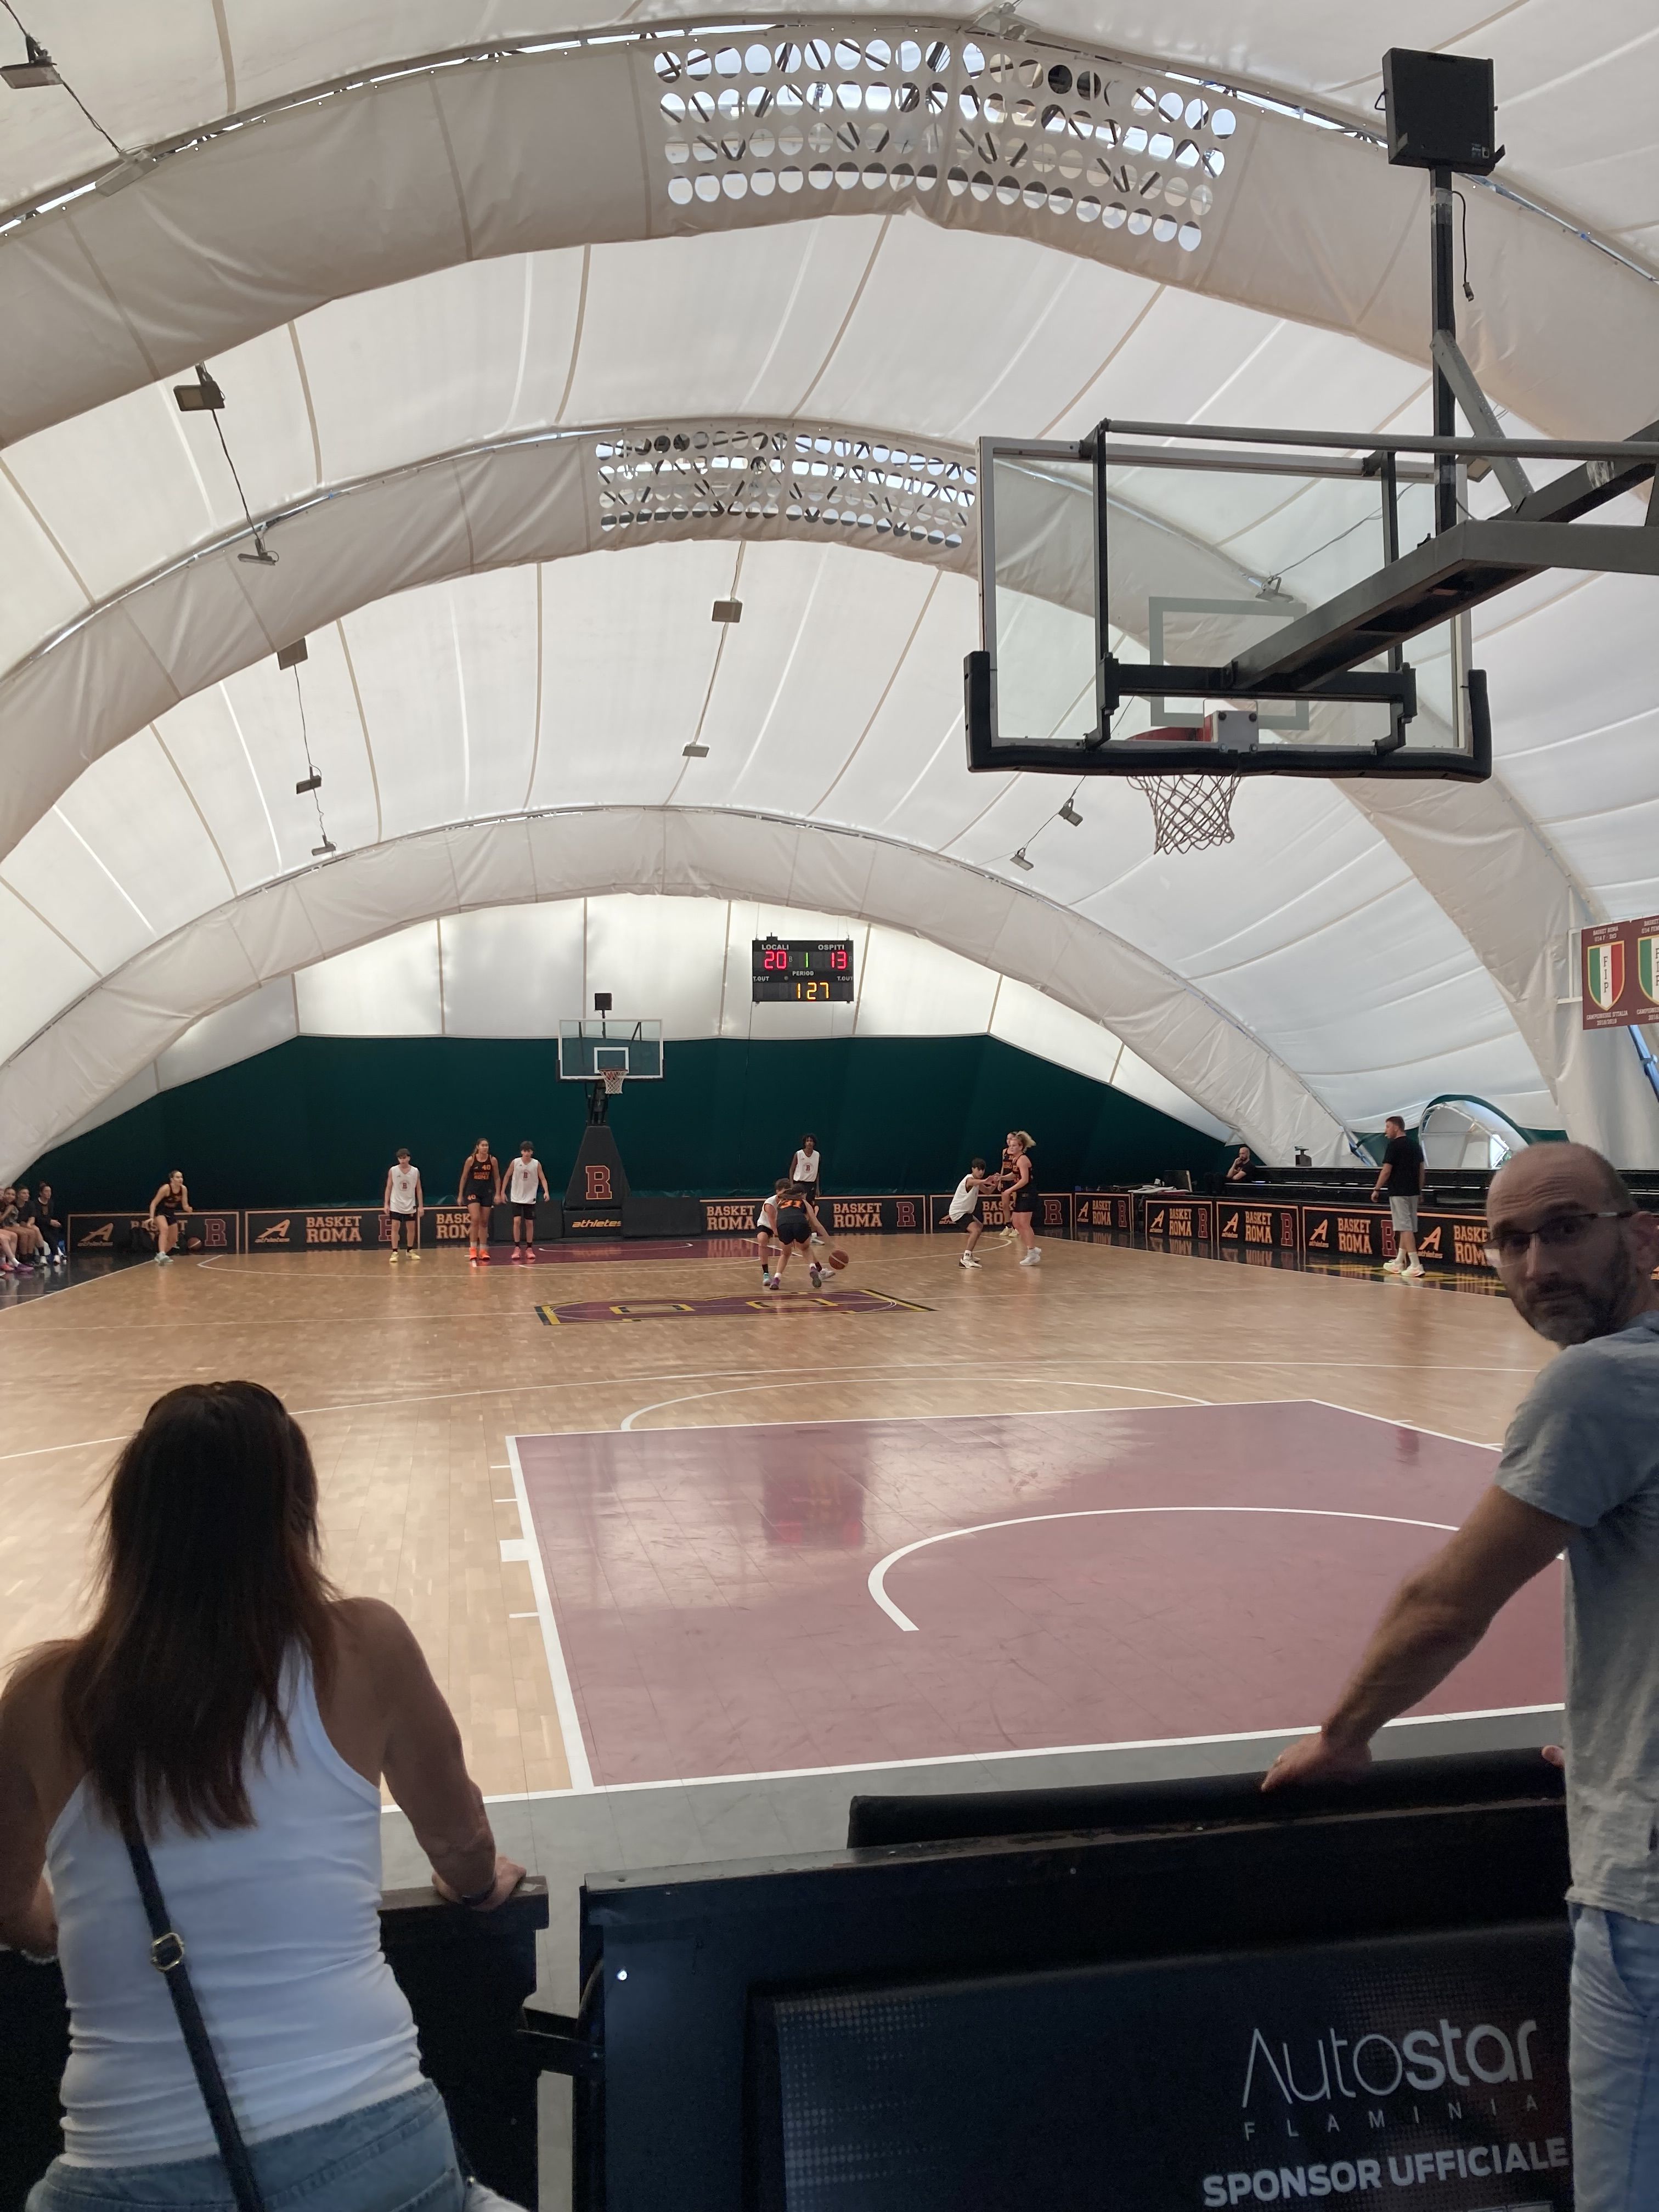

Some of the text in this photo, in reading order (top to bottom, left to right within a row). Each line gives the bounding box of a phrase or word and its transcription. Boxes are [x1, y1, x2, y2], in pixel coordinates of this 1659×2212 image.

[764, 951, 787, 969] 20
[831, 951, 847, 969] 13
[707, 1205, 755, 1216] BASKET
[833, 1203, 882, 1214] BASKET
[983, 1201, 1014, 1211] BASK
[1092, 1200, 1111, 1211] BASKET
[306, 1215, 362, 1228] BASKET
[436, 1213, 472, 1224] BASK
[833, 1213, 882, 1228] ROMA
[1092, 1210, 1111, 1226] ROMA
[1169, 1208, 1192, 1220] BASKET
[1245, 1211, 1272, 1226] BASKET
[436, 1224, 471, 1239] ROM
[707, 1216, 755, 1231] ROMA
[1169, 1220, 1192, 1237] ROMA
[1338, 1217, 1371, 1234] BASKET
[307, 1227, 362, 1243] ROMA
[1245, 1224, 1273, 1244] ROMA
[1454, 1224, 1488, 1243] BASKE
[1338, 1232, 1373, 1255] ROMA
[1454, 1241, 1488, 1267] ROM
[1242, 2018, 1538, 2108] Autostar
[1244, 2094, 1538, 2141] FLAMINIA
[1203, 2137, 1570, 2208] SPONSOR UFFICIALE
